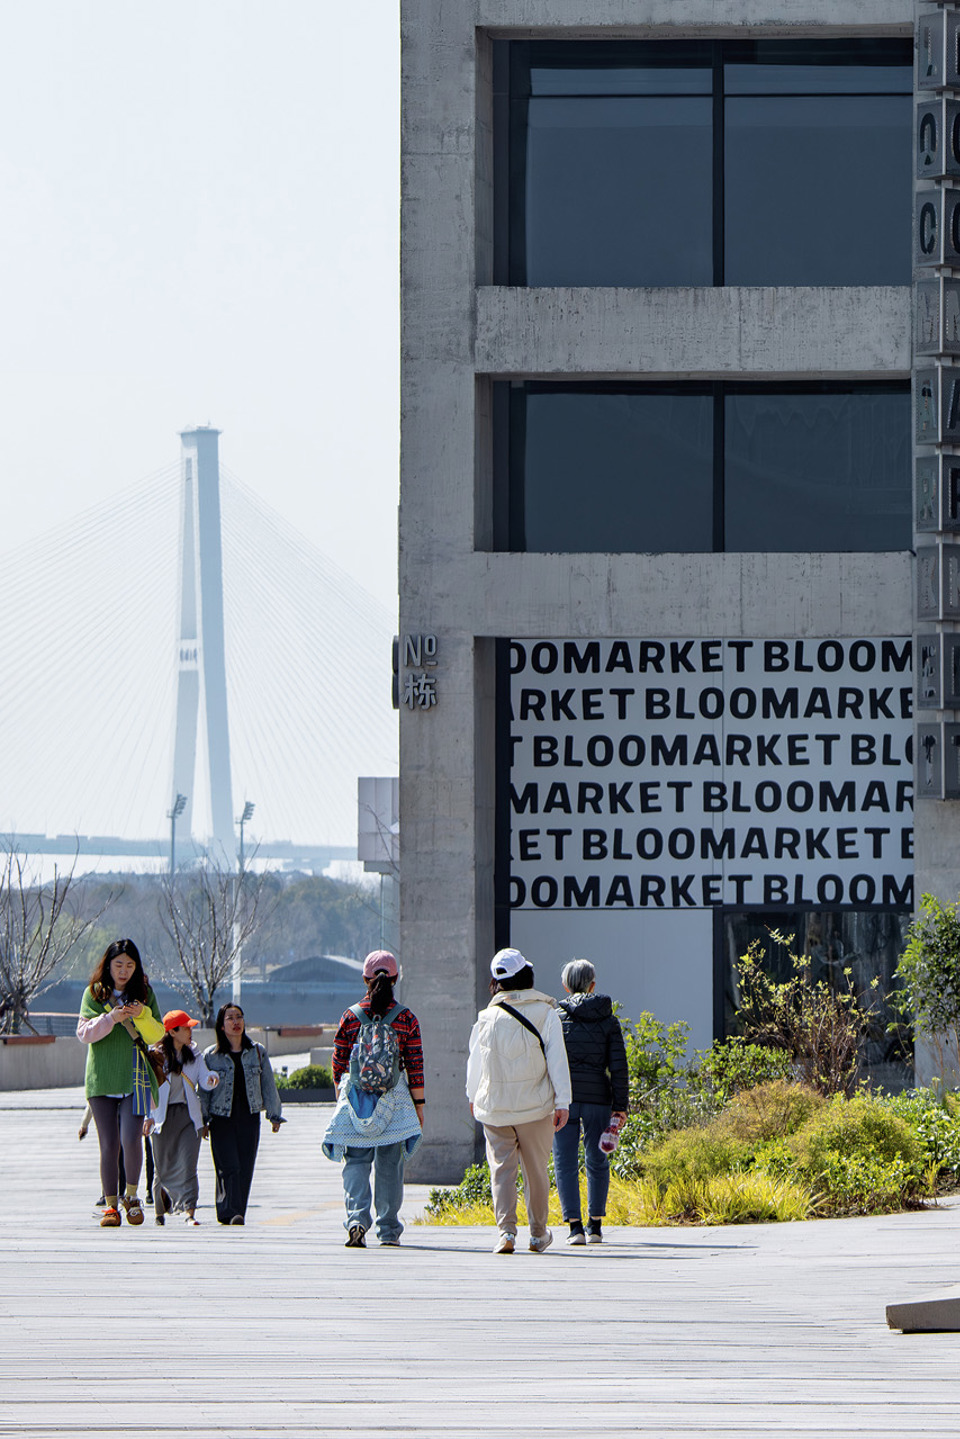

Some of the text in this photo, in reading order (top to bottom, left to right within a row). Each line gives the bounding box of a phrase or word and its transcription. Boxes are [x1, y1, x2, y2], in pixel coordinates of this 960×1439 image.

[764, 640, 913, 673] BLOOM
[402, 673, 438, 710] 栋
[510, 687, 635, 722] RKET
[533, 734, 840, 767] BLOOMARKET
[851, 733, 913, 766] BL
[510, 781, 692, 814] MARKET
[510, 828, 573, 861] ET
[582, 827, 891, 860] BLOOMARKET
